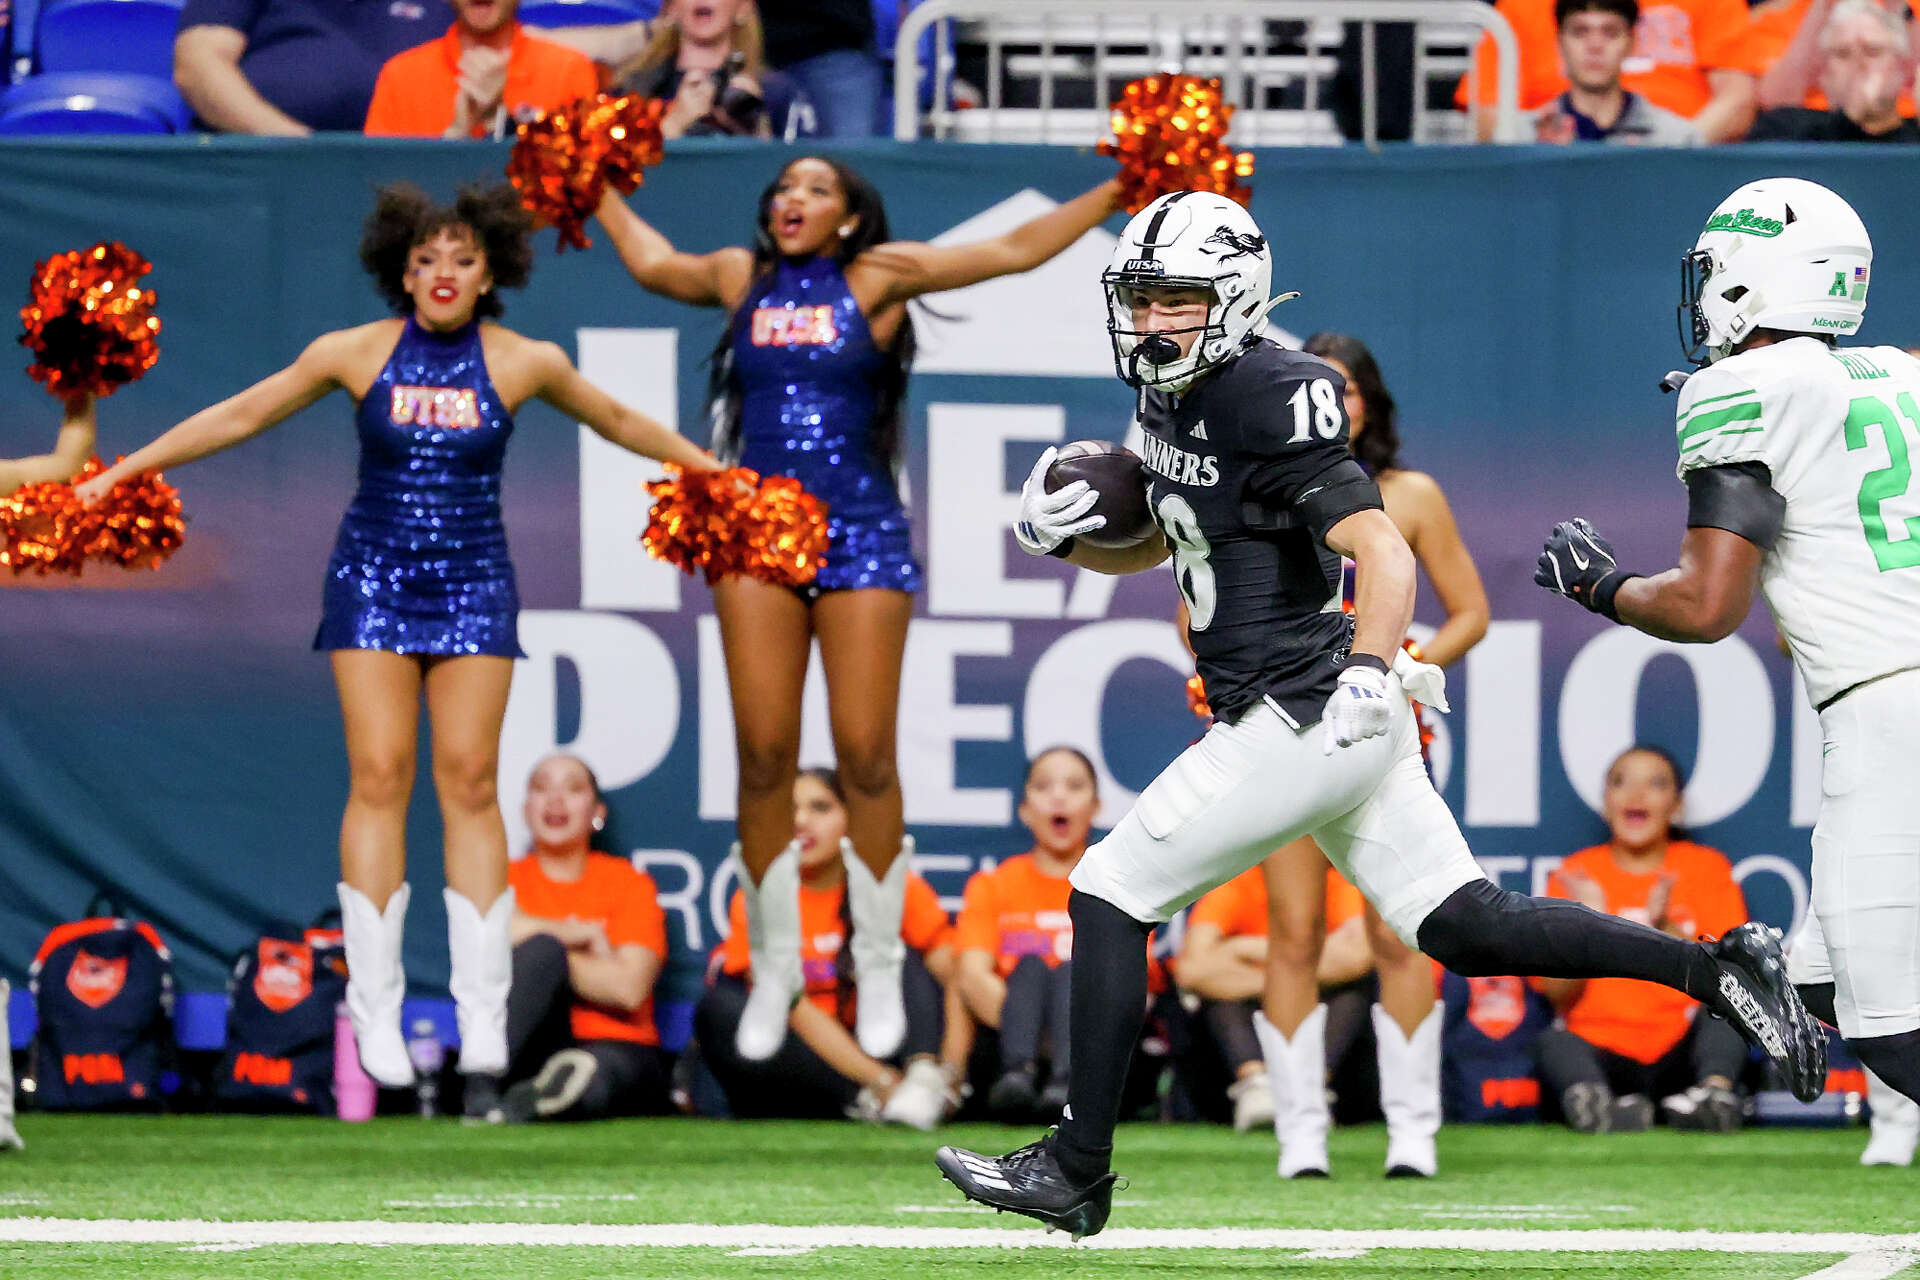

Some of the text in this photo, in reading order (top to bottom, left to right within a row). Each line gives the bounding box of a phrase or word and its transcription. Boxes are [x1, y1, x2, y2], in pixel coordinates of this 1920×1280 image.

[1127, 260, 1159, 271] UTSA
[1811, 316, 1840, 328] MEAN
[391, 384, 481, 429] UTSA
[1286, 378, 1343, 444] 18
[1144, 432, 1220, 487] NNERS
